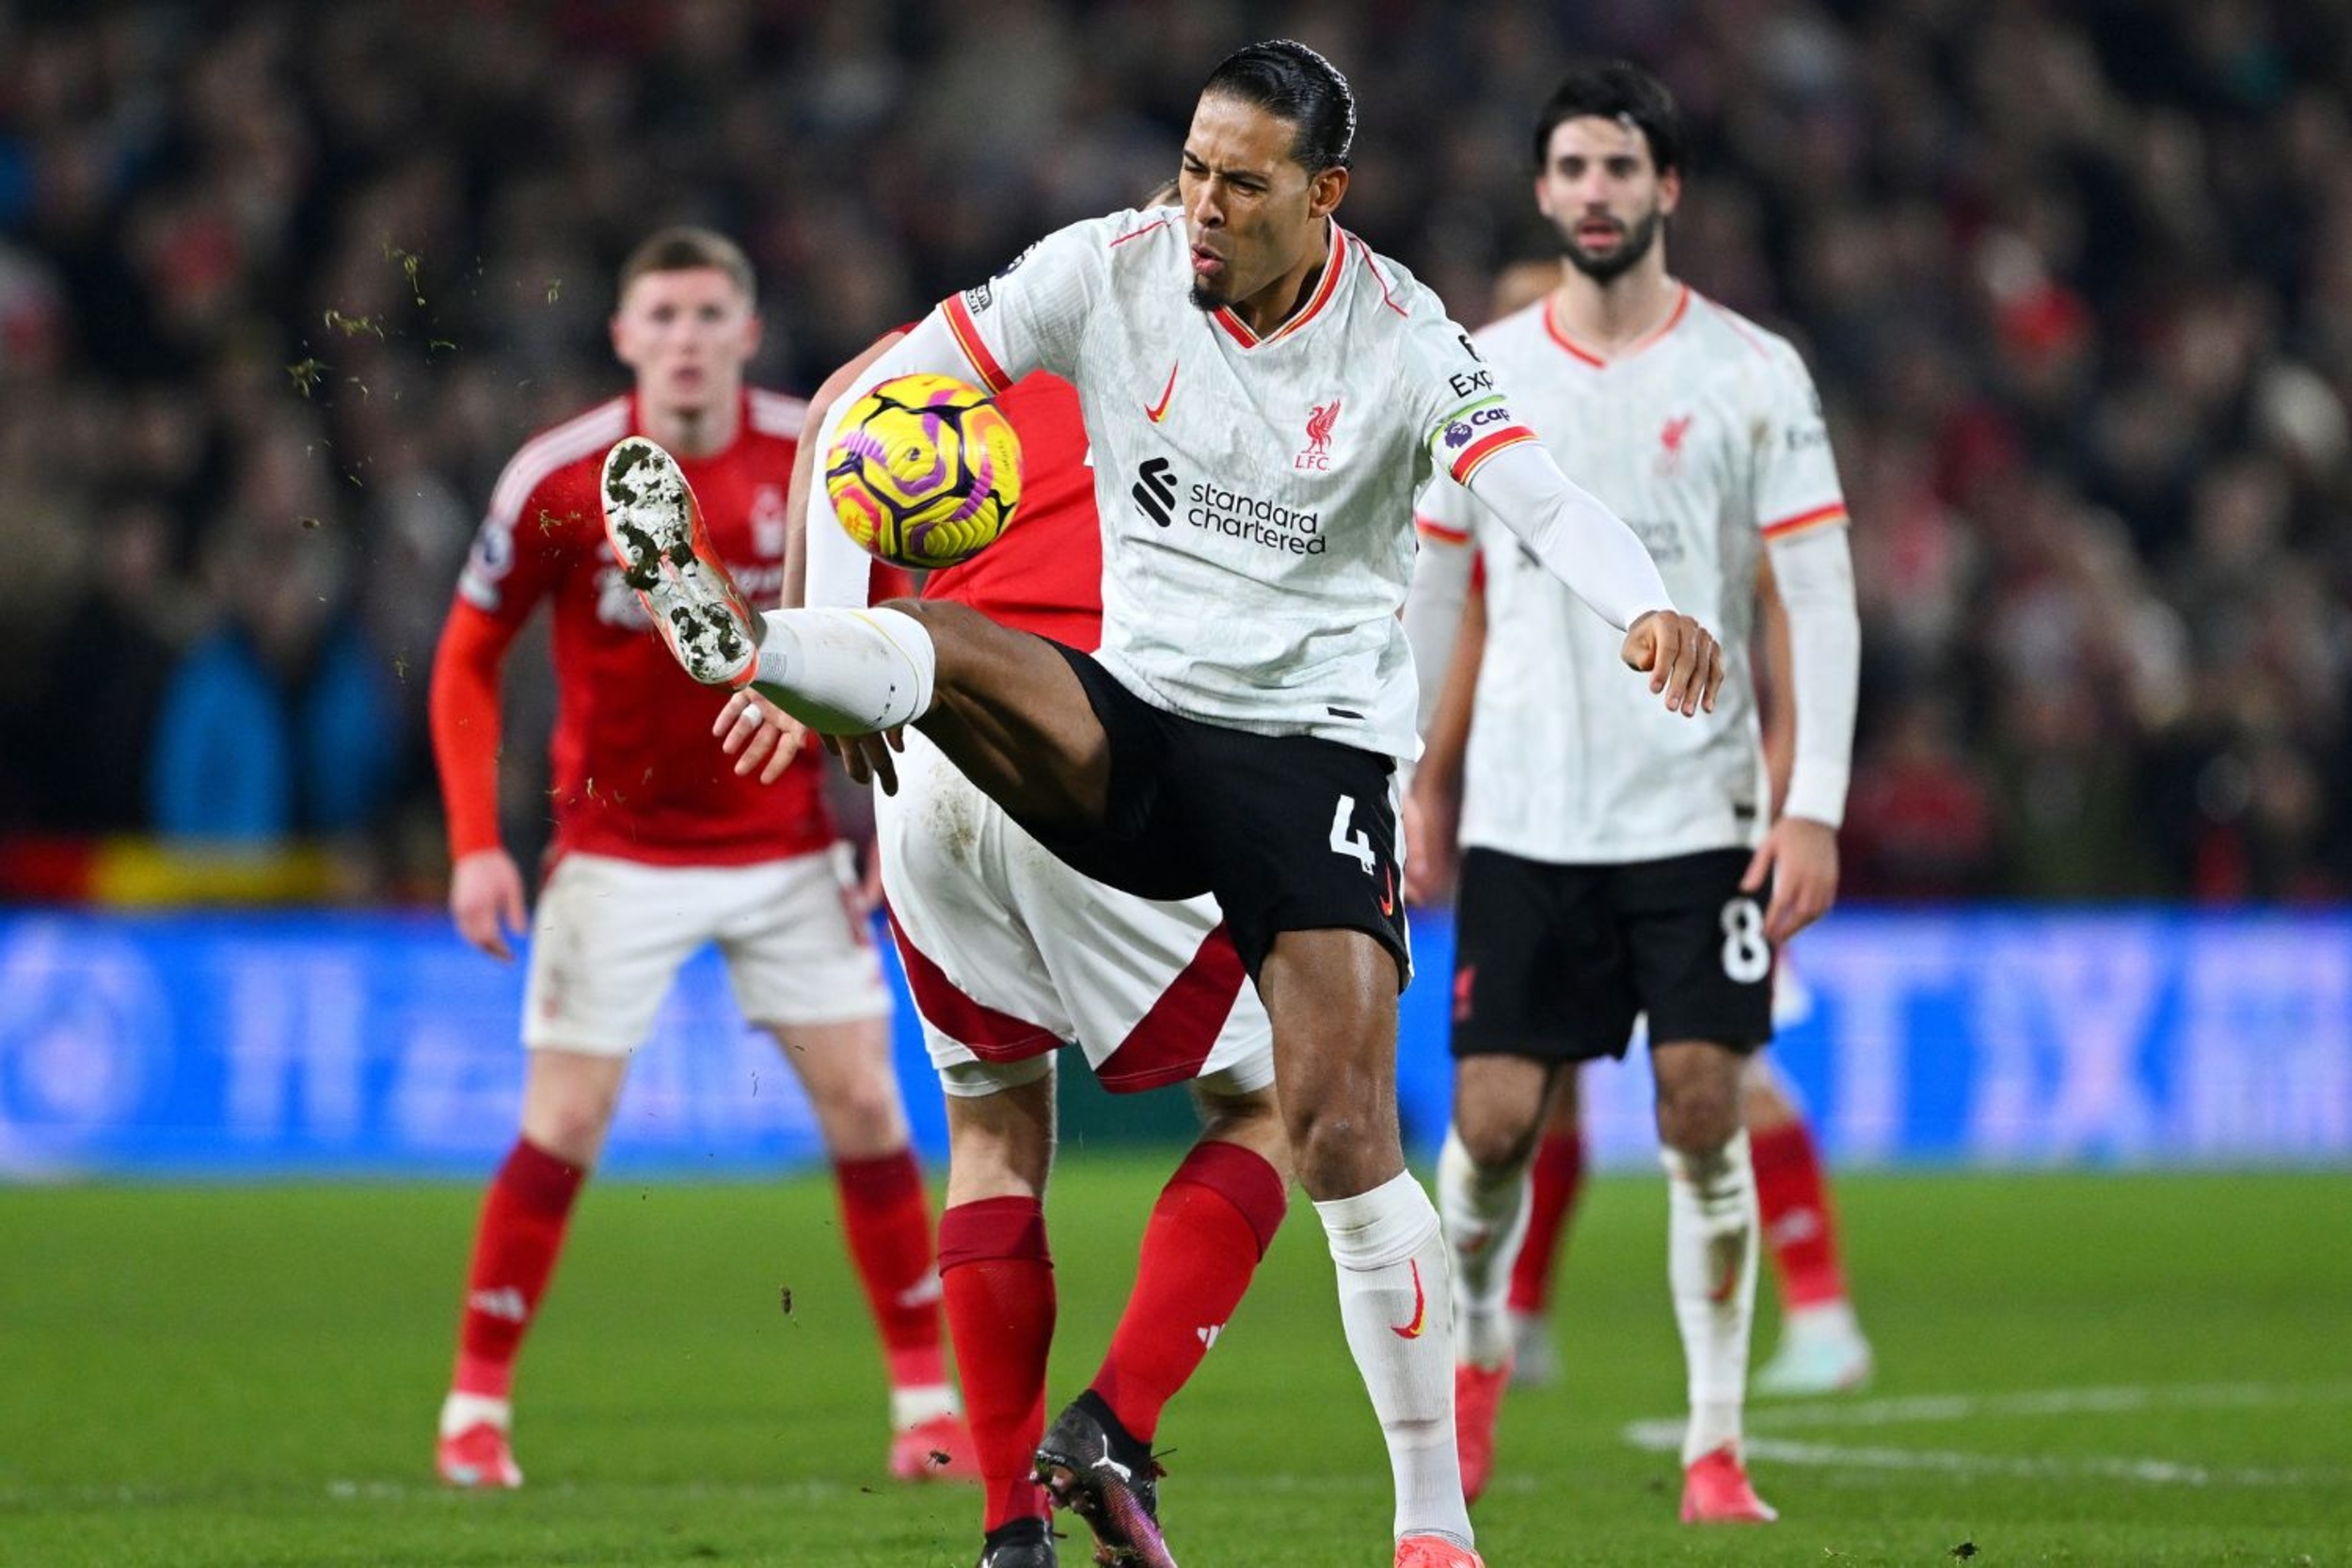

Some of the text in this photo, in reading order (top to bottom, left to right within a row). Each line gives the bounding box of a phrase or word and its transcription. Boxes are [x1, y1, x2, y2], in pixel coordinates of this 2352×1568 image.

[1188, 508, 1327, 554] chartered
[1190, 483, 1318, 534] standard
[1329, 795, 1376, 876] 4
[1720, 897, 1770, 984] 8
